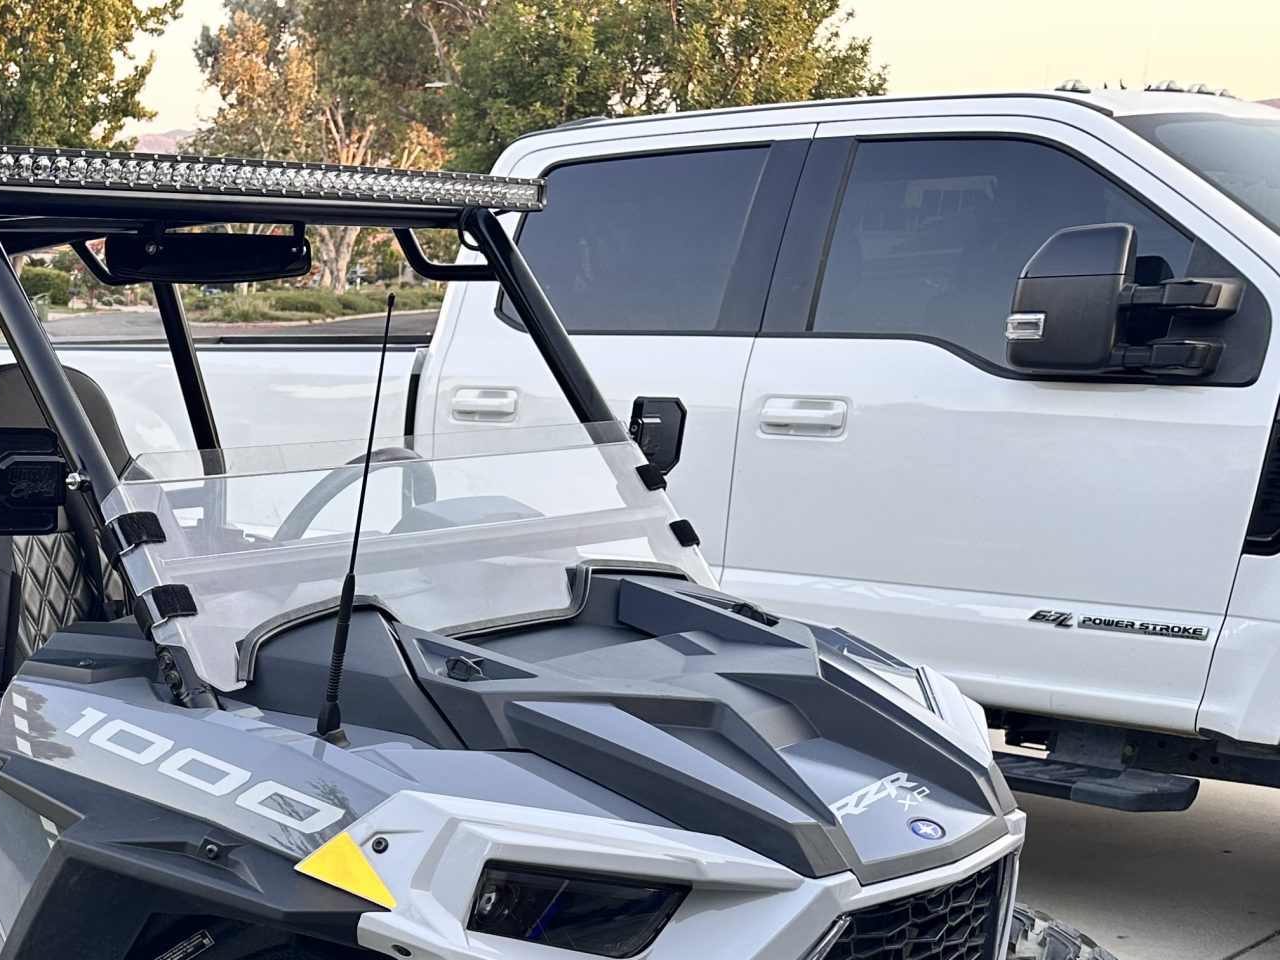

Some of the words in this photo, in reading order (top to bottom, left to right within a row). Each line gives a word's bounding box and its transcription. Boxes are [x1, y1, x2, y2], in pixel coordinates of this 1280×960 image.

[1081, 616, 1135, 629] POWER
[1138, 622, 1204, 636] STROKE
[65, 707, 345, 833] 1000
[829, 771, 919, 824] RZR
[896, 786, 930, 812] XP
